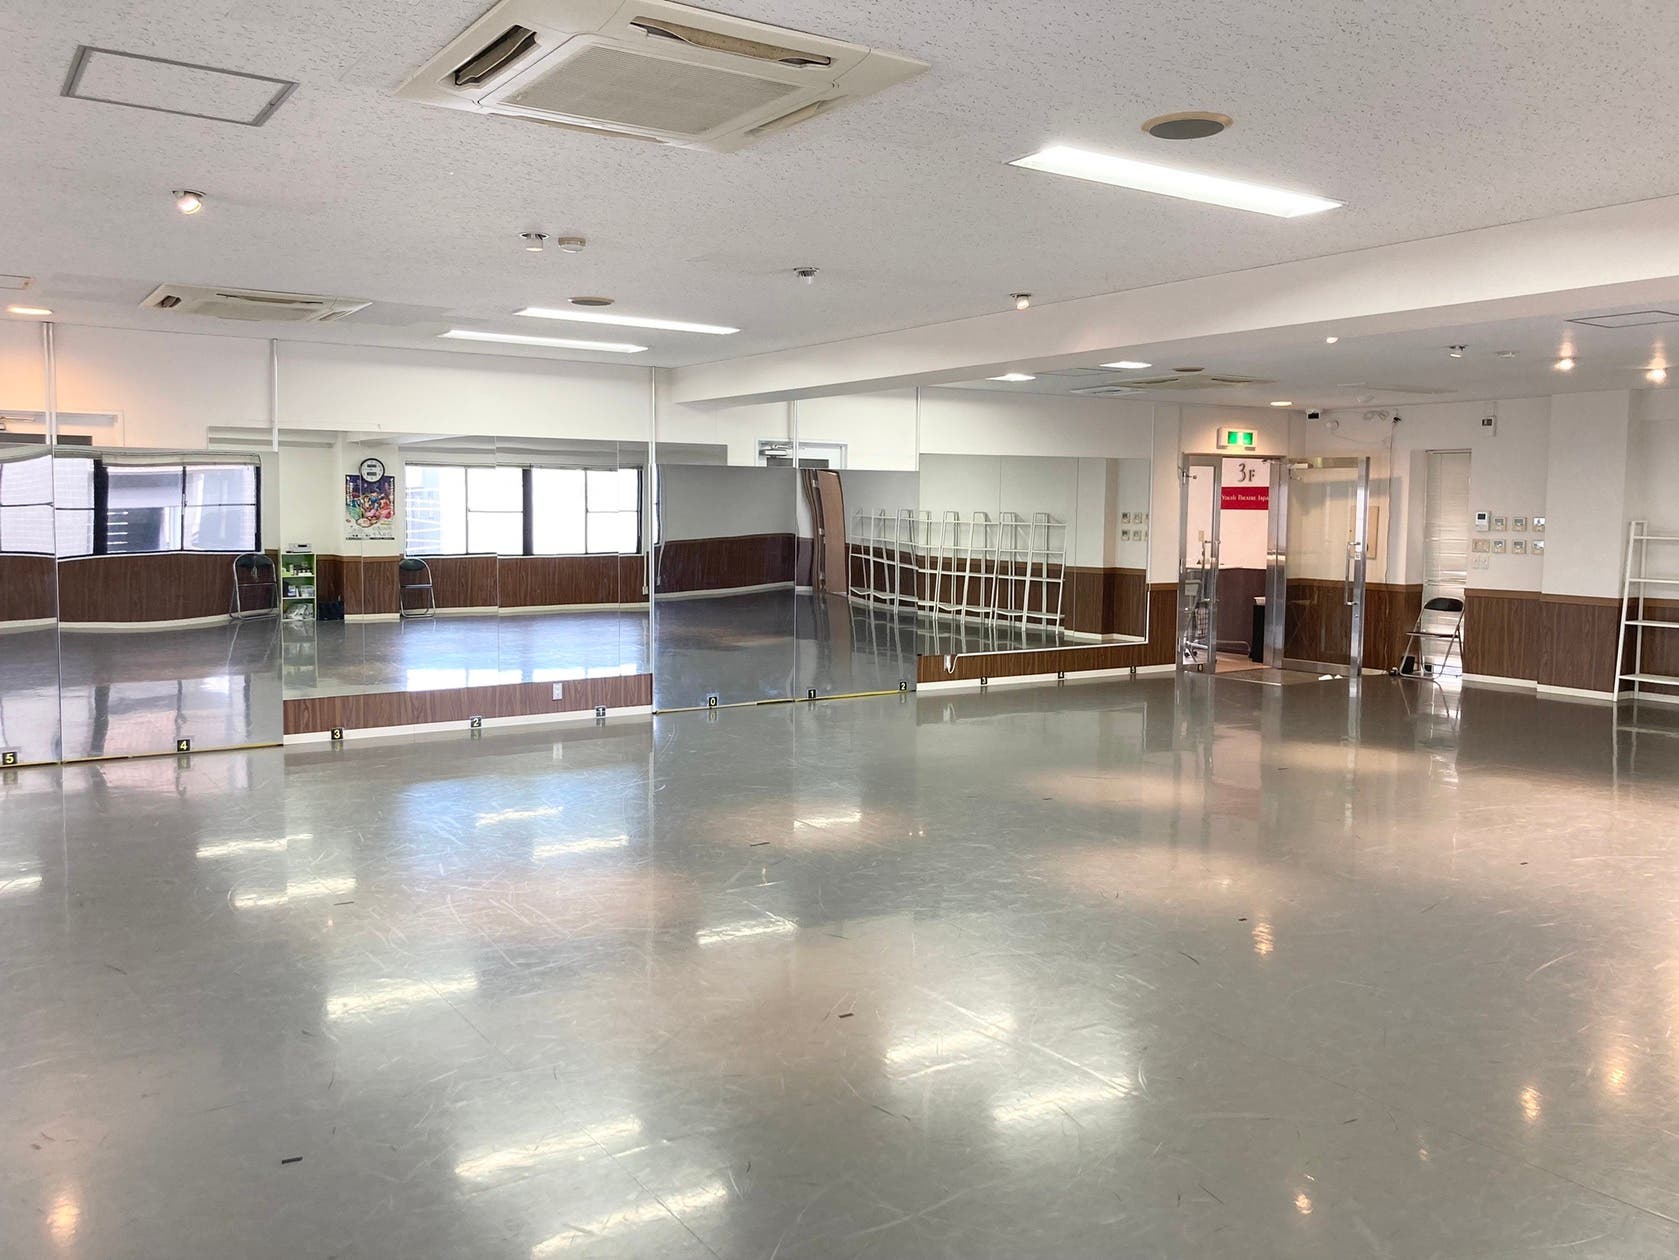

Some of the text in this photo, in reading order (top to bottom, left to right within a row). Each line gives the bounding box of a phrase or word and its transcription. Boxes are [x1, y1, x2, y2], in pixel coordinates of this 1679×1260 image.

[1238, 463, 1255, 482] 3F
[474, 718, 479, 726] 2
[335, 730, 340, 738] 3
[180, 740, 188, 750] 4
[6, 753, 14, 763] 5
